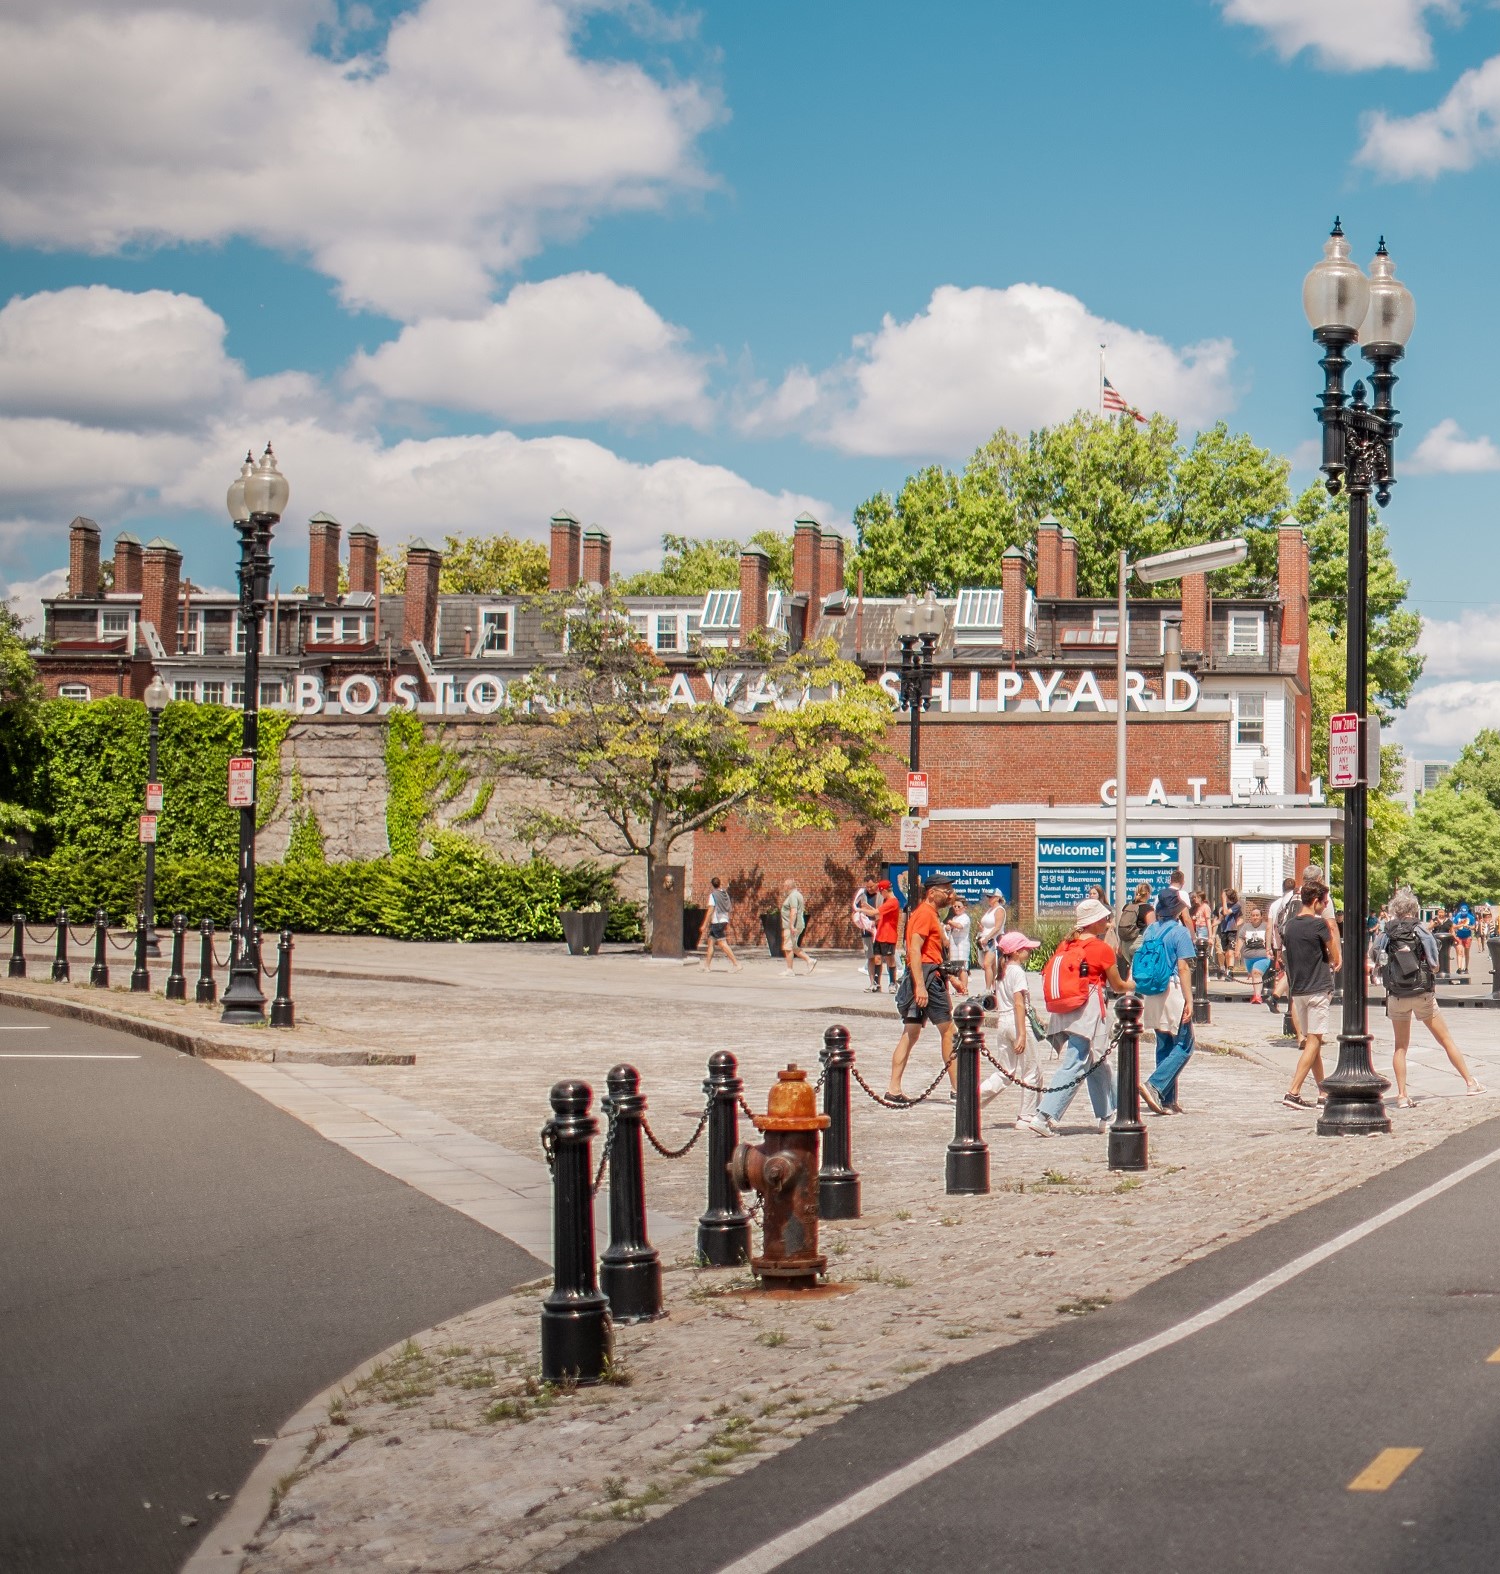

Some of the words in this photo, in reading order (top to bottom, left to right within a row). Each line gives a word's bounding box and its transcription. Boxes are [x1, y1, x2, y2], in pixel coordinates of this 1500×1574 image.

[1332, 720, 1343, 731] TOW
[1343, 719, 1356, 730] ZONE
[1340, 736, 1348, 744] NO
[1333, 746, 1355, 755] STOPPING
[1309, 777, 1325, 803] 1
[1040, 844, 1104, 855] Welcome!
[935, 869, 960, 877] Boston
[962, 869, 994, 877] National
